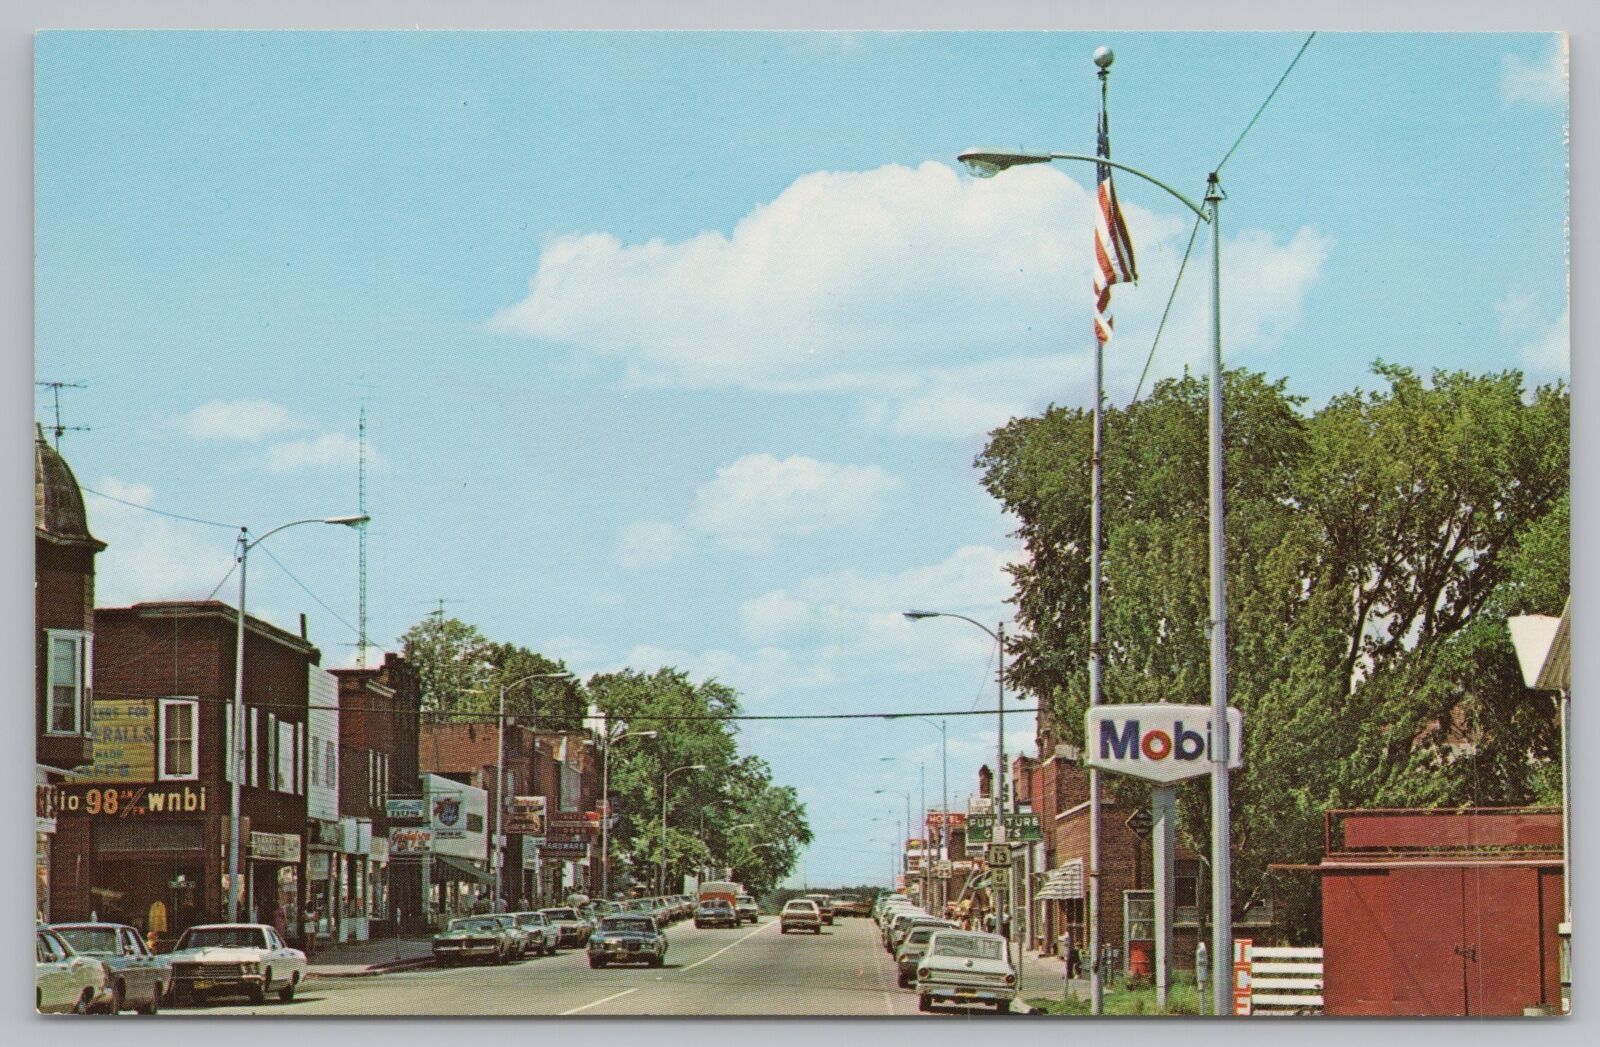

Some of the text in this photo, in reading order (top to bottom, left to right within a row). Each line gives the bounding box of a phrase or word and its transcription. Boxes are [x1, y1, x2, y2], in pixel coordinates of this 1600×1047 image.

[86, 788, 119, 815] 98
[148, 786, 206, 811] wnbi
[929, 815, 961, 824] HOEL
[969, 817, 1040, 828] FURTURE
[983, 828, 1021, 838] GTS
[542, 842, 584, 850] ARDWARE
[993, 852, 1007, 864] 13
